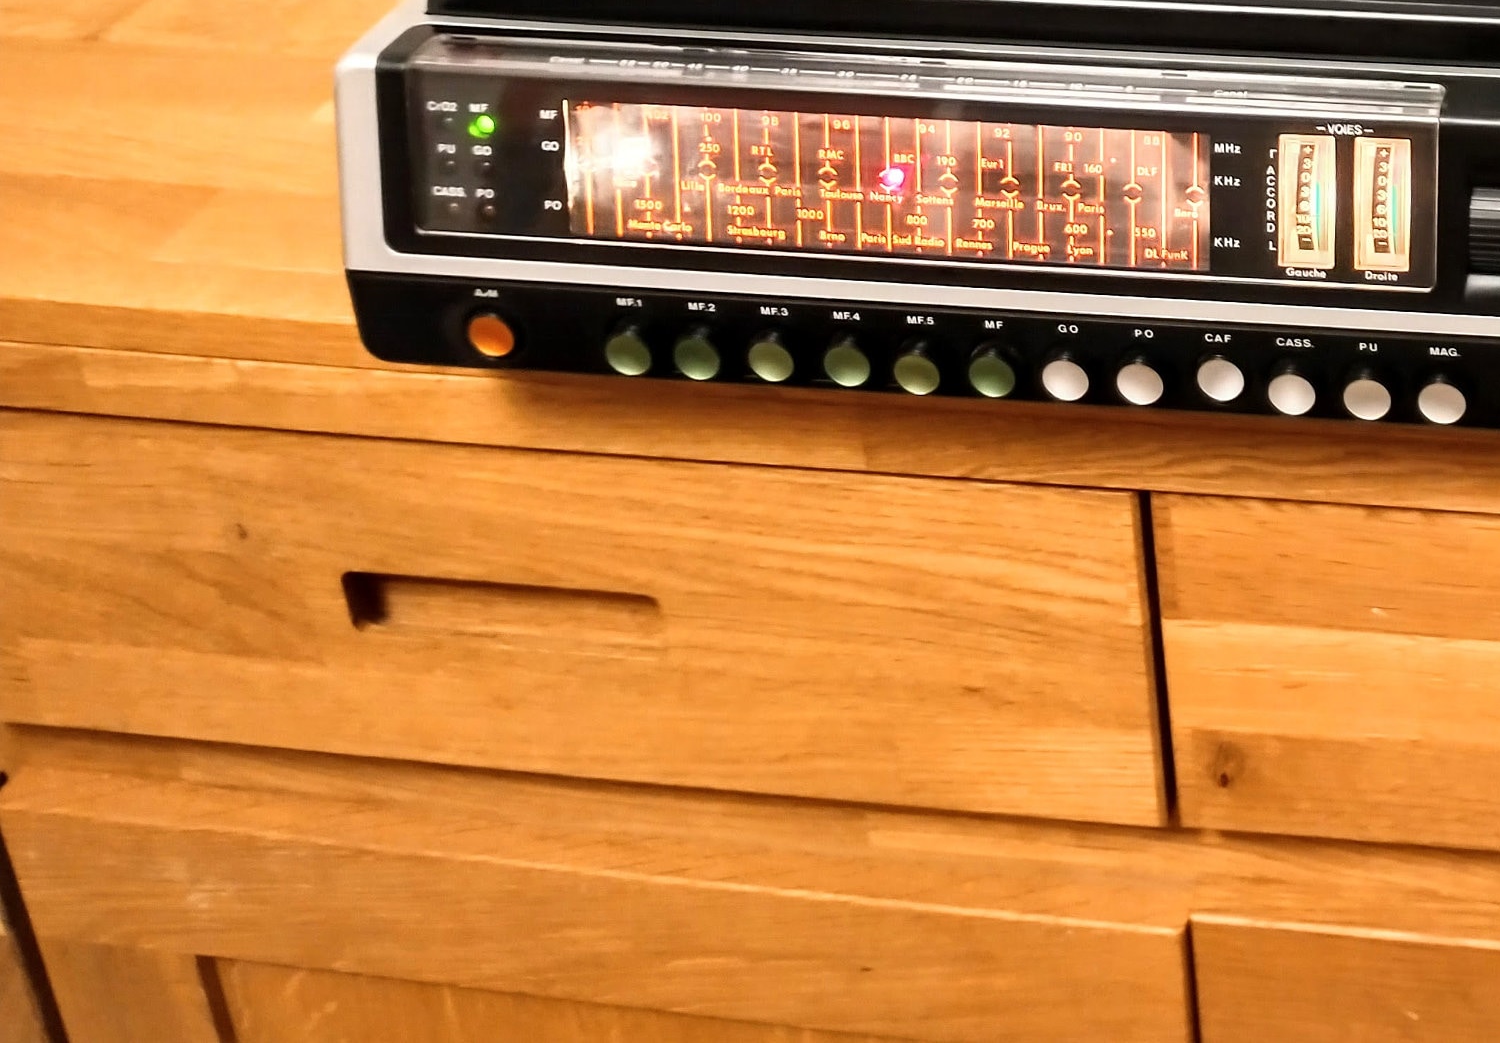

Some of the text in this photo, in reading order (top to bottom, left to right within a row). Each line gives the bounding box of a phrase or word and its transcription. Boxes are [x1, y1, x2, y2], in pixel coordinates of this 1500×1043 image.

[761, 116, 779, 127] 98
[833, 119, 851, 130] 96
[919, 123, 936, 134] 94
[994, 128, 1010, 139] 92
[1064, 131, 1082, 143] 90
[1214, 142, 1242, 154] MHz
[1327, 123, 1363, 136] VOIES
[541, 140, 560, 152] GO
[699, 143, 720, 154] 250
[751, 145, 773, 157] RTL
[818, 150, 844, 160] RMC
[894, 153, 915, 164] BBC
[936, 156, 957, 167] 190
[1084, 163, 1103, 175] 160
[1136, 165, 1158, 177] DLF
[1214, 175, 1242, 187] KHz
[475, 188, 494, 199] PO
[718, 182, 769, 195] Bordeaux
[774, 186, 801, 198] Paris
[820, 187, 864, 200] Toulouse
[870, 191, 904, 204] Nancy
[975, 197, 1025, 210] Marseille
[1077, 202, 1105, 214] Paris
[544, 199, 562, 211] PO
[634, 199, 663, 210] 1500
[727, 205, 755, 216] 1200
[797, 209, 824, 220] 1000
[906, 214, 928, 226] 800
[972, 218, 994, 229] 700
[1064, 223, 1088, 235] 600
[1214, 237, 1241, 249] KHz
[727, 225, 786, 241] Strasbourg
[892, 233, 912, 246] Sud
[1012, 242, 1051, 255] Prague
[1067, 243, 1093, 256] Lyon
[1286, 267, 1327, 279] Gauche
[1364, 270, 1398, 282] Droite
[688, 301, 716, 312] MF.2
[760, 306, 789, 317] MF.3
[832, 310, 860, 321] MF.4
[906, 315, 934, 326] MF.5
[984, 319, 1003, 330] MF
[1204, 333, 1232, 344] CAF
[1275, 337, 1314, 349] CASS.
